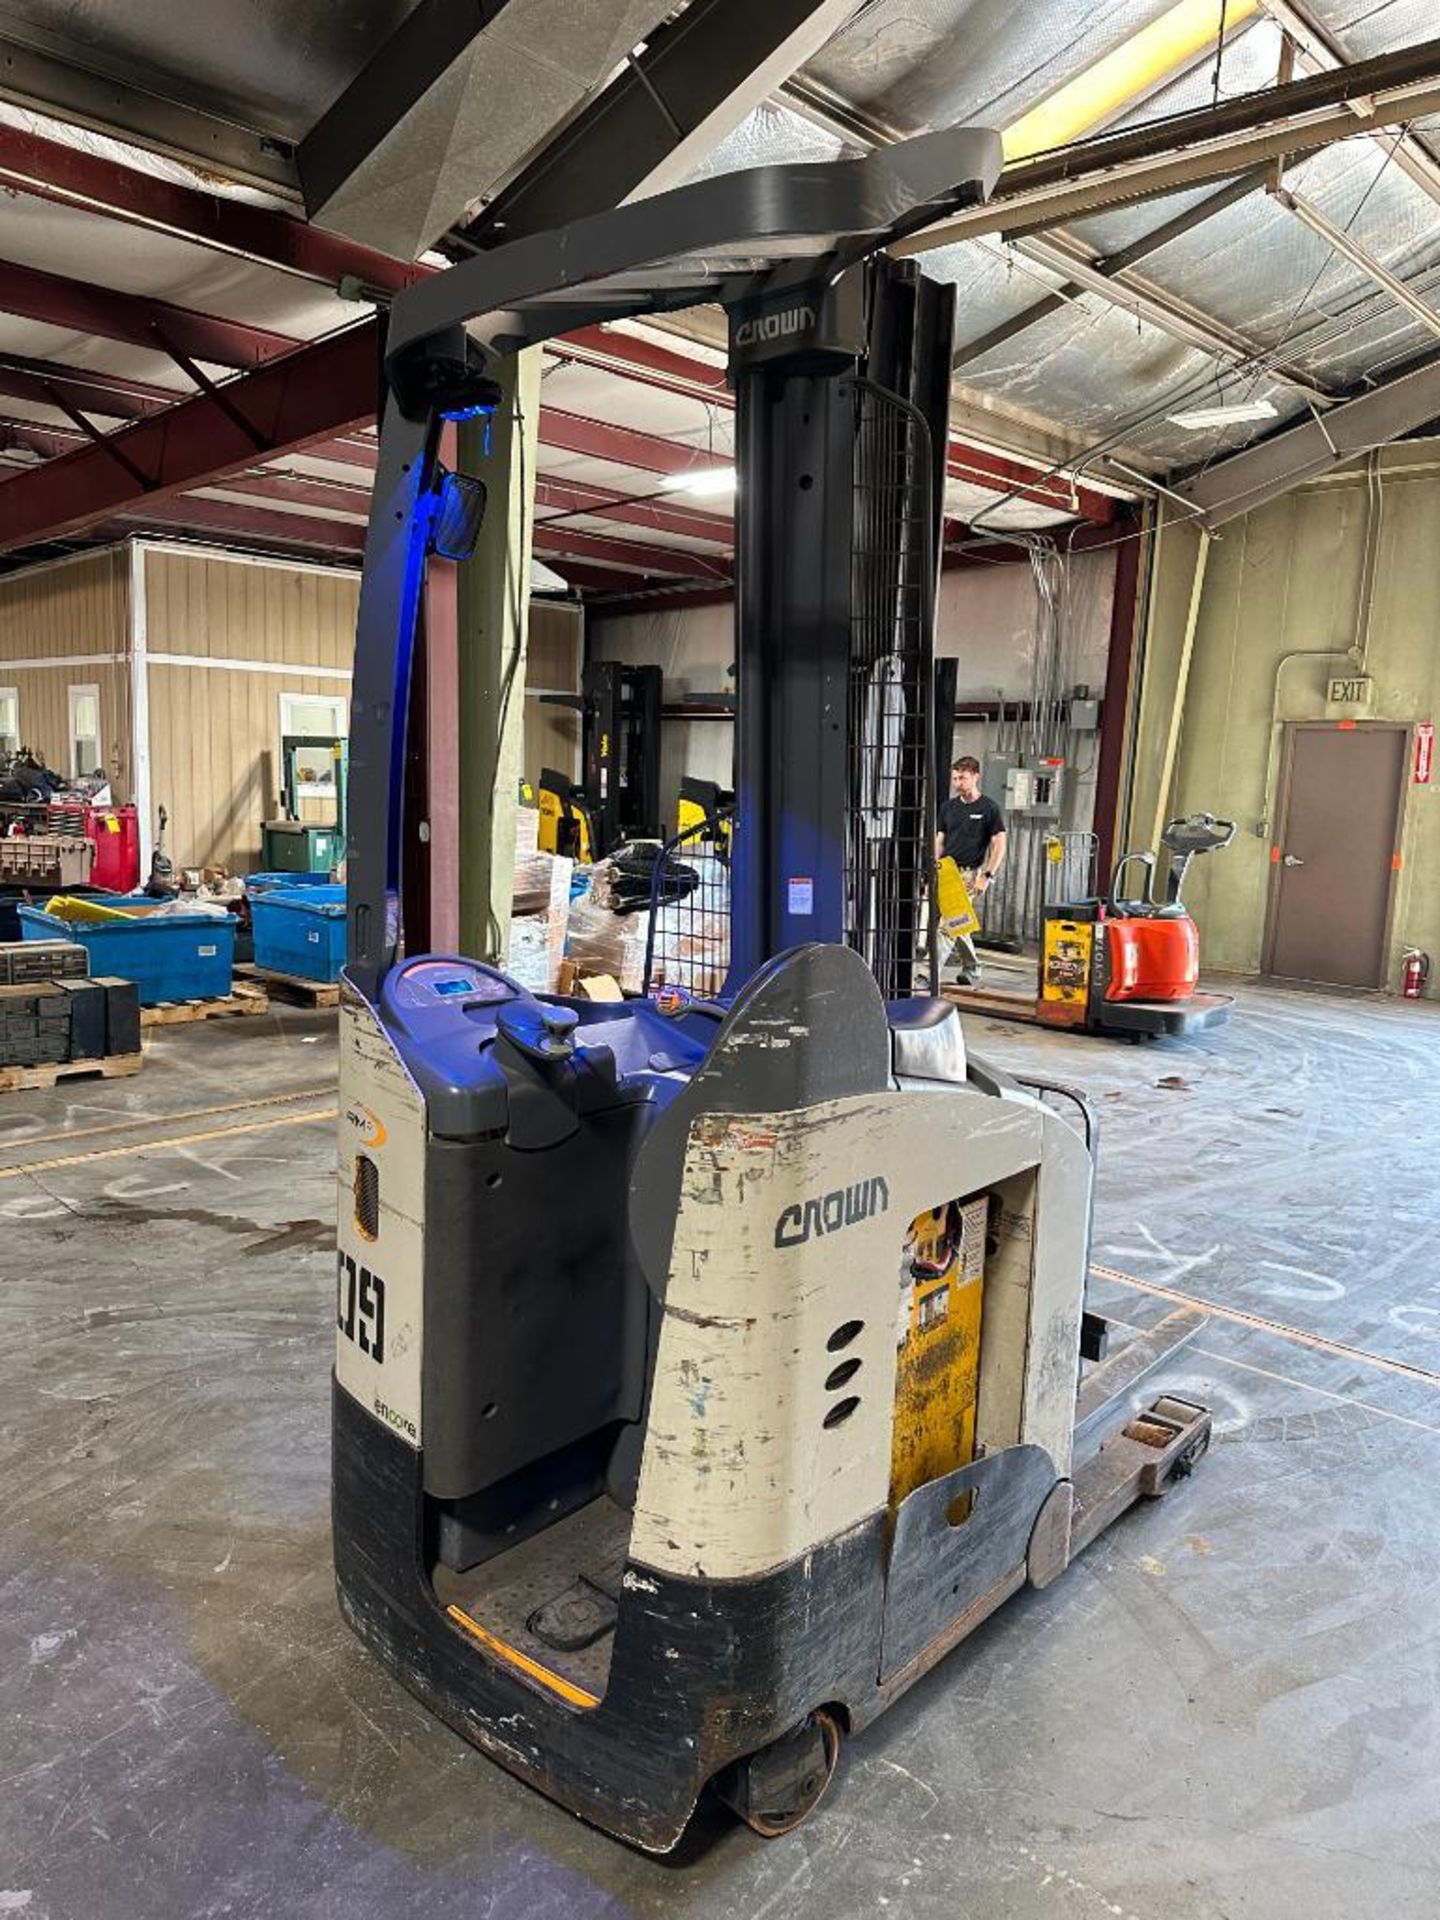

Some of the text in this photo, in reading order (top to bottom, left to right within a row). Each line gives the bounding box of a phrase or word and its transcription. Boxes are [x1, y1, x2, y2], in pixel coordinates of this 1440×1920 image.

[736, 306, 816, 345] CROWN
[1331, 681, 1365, 702] EXIT
[775, 1176, 889, 1248] CROWN
[374, 1399, 416, 1439] encore
